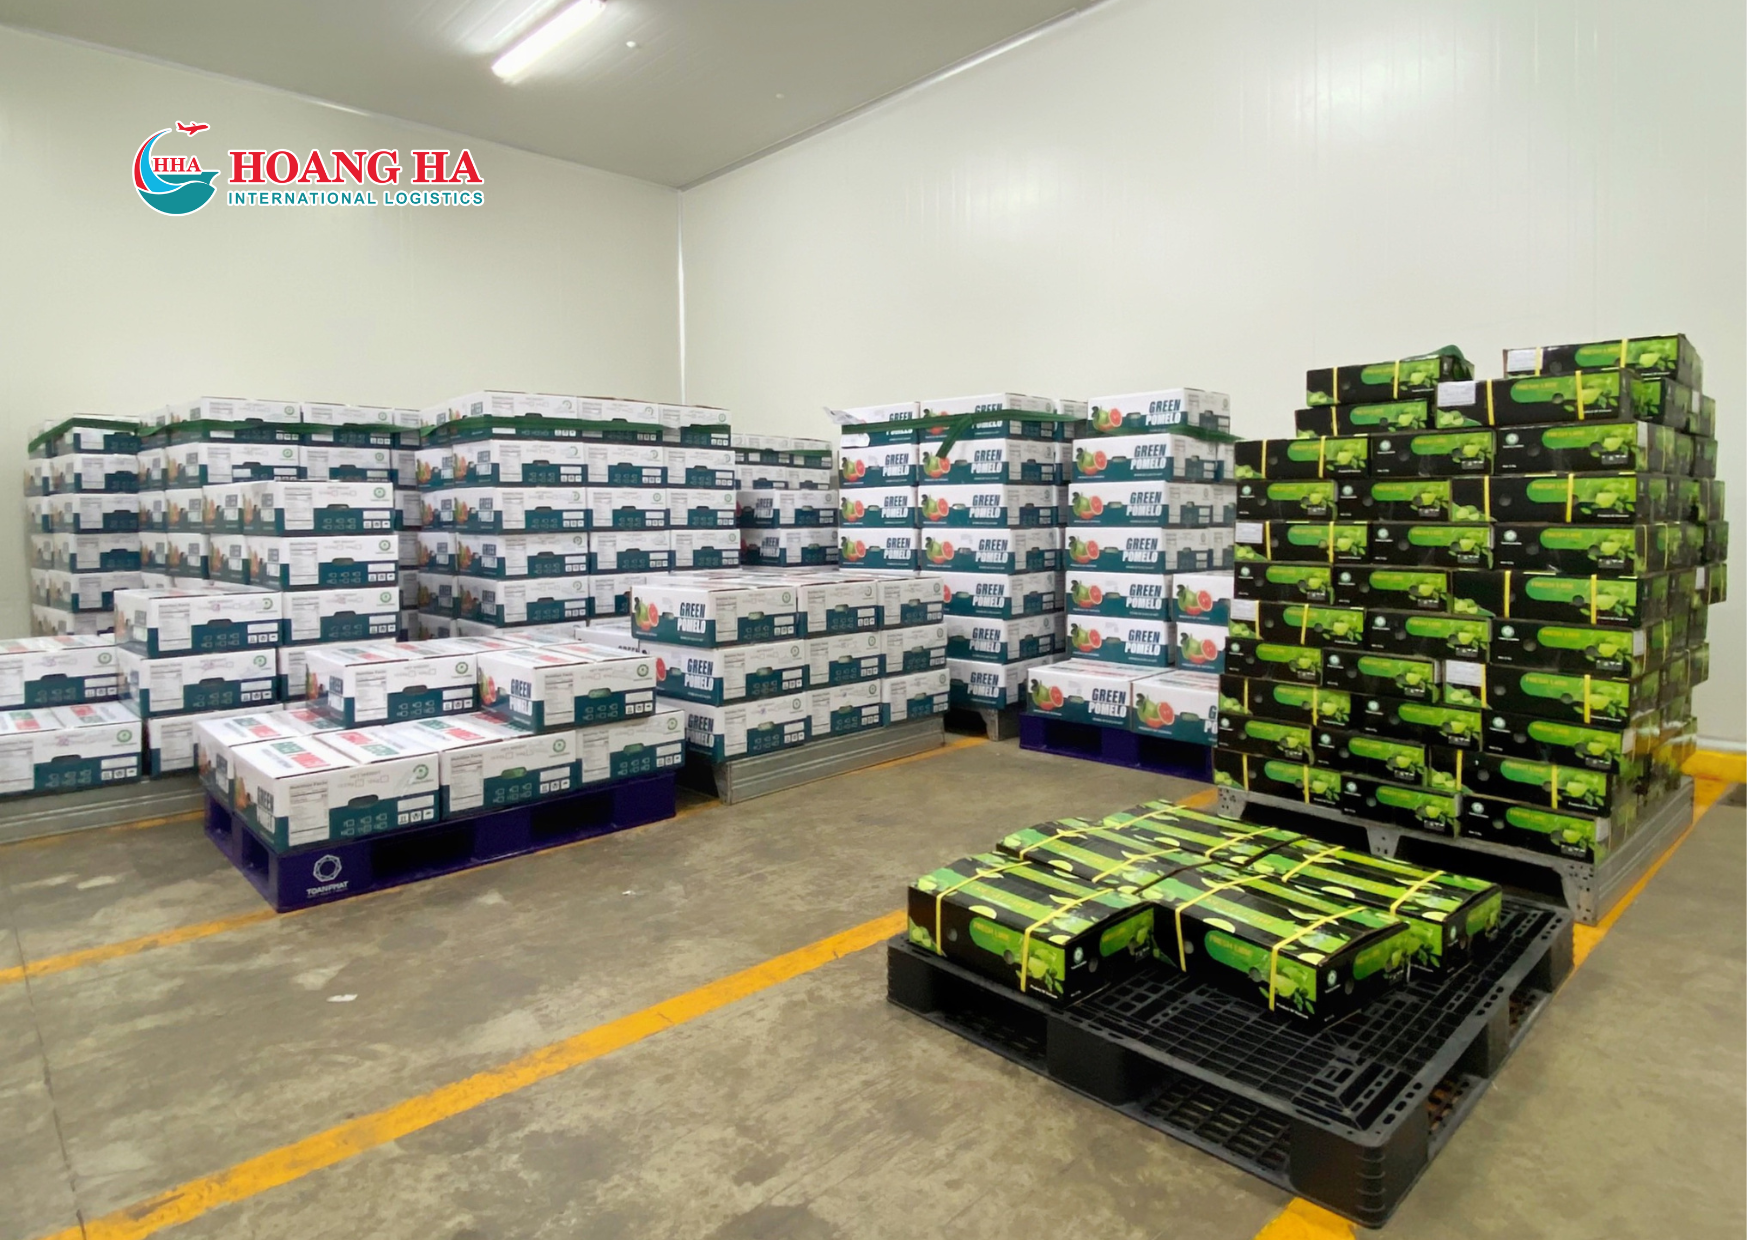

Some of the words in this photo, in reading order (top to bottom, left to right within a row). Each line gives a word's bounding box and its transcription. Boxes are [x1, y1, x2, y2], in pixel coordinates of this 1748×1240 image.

[1149, 399, 1181, 414] GREEN
[1145, 412, 1182, 426] POMELO
[974, 449, 1002, 462] GREEN
[1134, 444, 1167, 457] GREEN
[885, 453, 909, 466] GREEN
[1130, 457, 1167, 470] POMELO
[882, 465, 910, 477] POMELO
[971, 462, 1002, 475] POMELO
[884, 495, 908, 507] GREEN
[972, 495, 1000, 507] GREEN
[1130, 492, 1162, 504] GREEN
[881, 507, 908, 519] POMELO
[969, 506, 1001, 519] POMELO
[1126, 504, 1162, 517] POMELO
[886, 538, 911, 549] GREEN
[978, 539, 1008, 551] GREEN
[1126, 537, 1159, 550] GREEN
[883, 549, 912, 561] POMELO
[975, 551, 1008, 564] POMELO
[1122, 550, 1159, 563] POMELO
[975, 583, 1005, 596] GREEN
[1129, 584, 1162, 597] GREEN
[972, 596, 1005, 609] POMELO
[1125, 597, 1162, 610] POMELO
[680, 602, 706, 618] GREEN
[972, 627, 1001, 641] GREEN
[1128, 629, 1161, 643] GREEN
[1124, 642, 1161, 656] POMELO
[687, 658, 714, 676] GREEN
[970, 672, 999, 686] GREEN
[1092, 688, 1127, 705] GREEN
[1088, 703, 1127, 718] POMELO
[688, 714, 714, 733] GREEN
